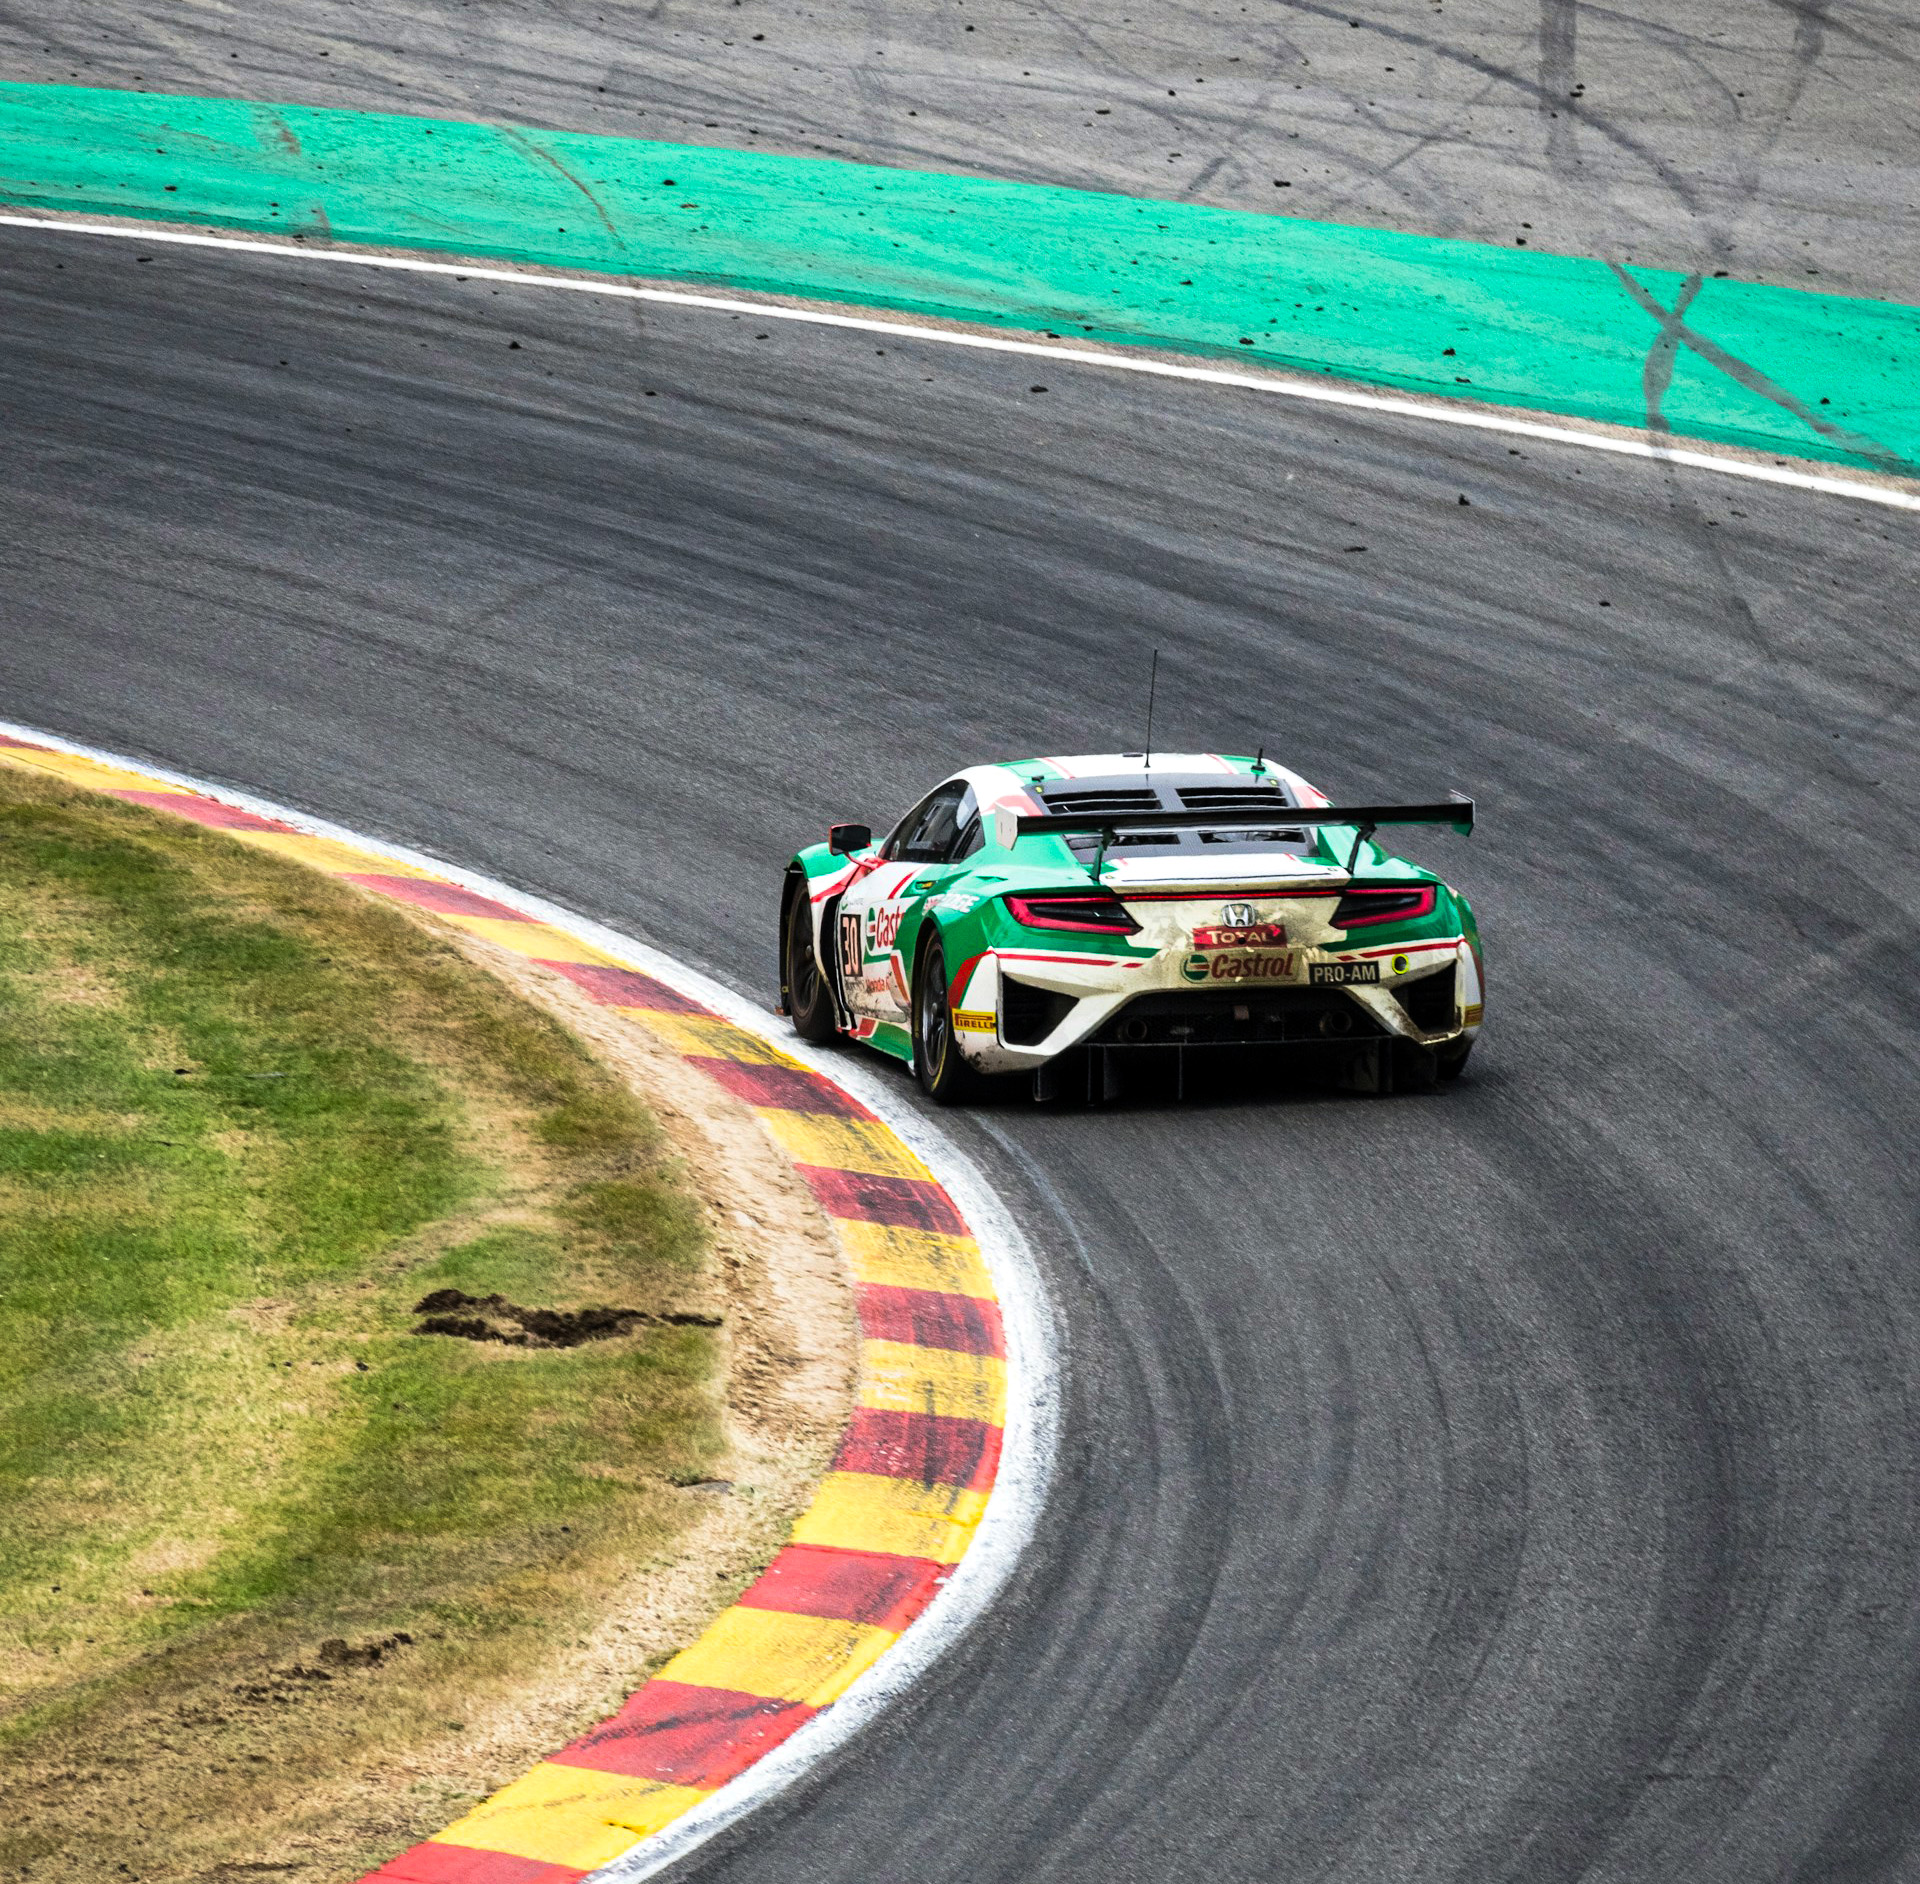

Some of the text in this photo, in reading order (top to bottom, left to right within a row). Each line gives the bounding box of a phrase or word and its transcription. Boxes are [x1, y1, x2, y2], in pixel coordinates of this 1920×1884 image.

[842, 916, 859, 975] 30
[1211, 953, 1294, 978] Castrol
[1314, 964, 1377, 983] PRO-AM
[954, 1013, 994, 1029] PIRELLI
